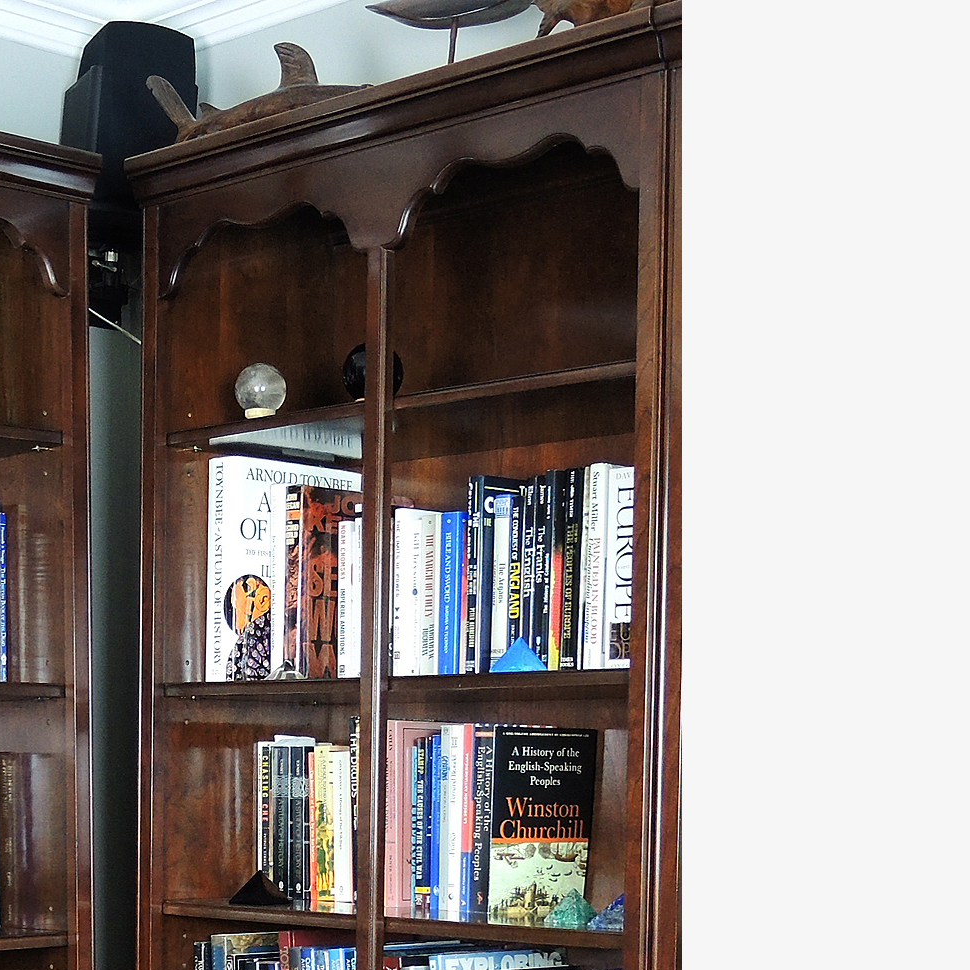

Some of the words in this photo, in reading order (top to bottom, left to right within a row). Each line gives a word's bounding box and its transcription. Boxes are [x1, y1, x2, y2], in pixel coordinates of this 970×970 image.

[214, 462, 224, 526] TOYNBEE
[246, 468, 297, 485] ARNOLD
[300, 475, 352, 491] TOYNBEE
[591, 471, 600, 500] Stuart
[240, 518, 268, 541] OF
[511, 520, 519, 550] CONQUEST
[524, 527, 533, 545] The
[537, 526, 545, 542] The
[590, 503, 600, 531] Miller
[214, 544, 222, 588] STUDY
[535, 544, 545, 584] Franks
[565, 545, 575, 585] PEOPLES
[593, 537, 601, 587] PAINTED
[614, 486, 635, 620] EUROPE
[508, 562, 520, 619] ENGLAND
[523, 547, 534, 598] English
[214, 590, 221, 608] OF
[212, 610, 221, 665] HISTORY
[563, 601, 572, 639] EUROPE
[590, 605, 600, 645] BLOOD
[508, 760, 582, 774] English-Speaking
[511, 747, 520, 756] A
[522, 746, 555, 760] History
[567, 747, 580, 757] the
[350, 756, 358, 798] DRUIDS
[473, 746, 486, 839] English-Speaking
[483, 759, 493, 801] History
[530, 775, 561, 788] Peoples
[483, 815, 491, 832] the
[505, 796, 580, 818] Winston
[500, 819, 584, 839] Churchill
[472, 842, 483, 881] Peoples
